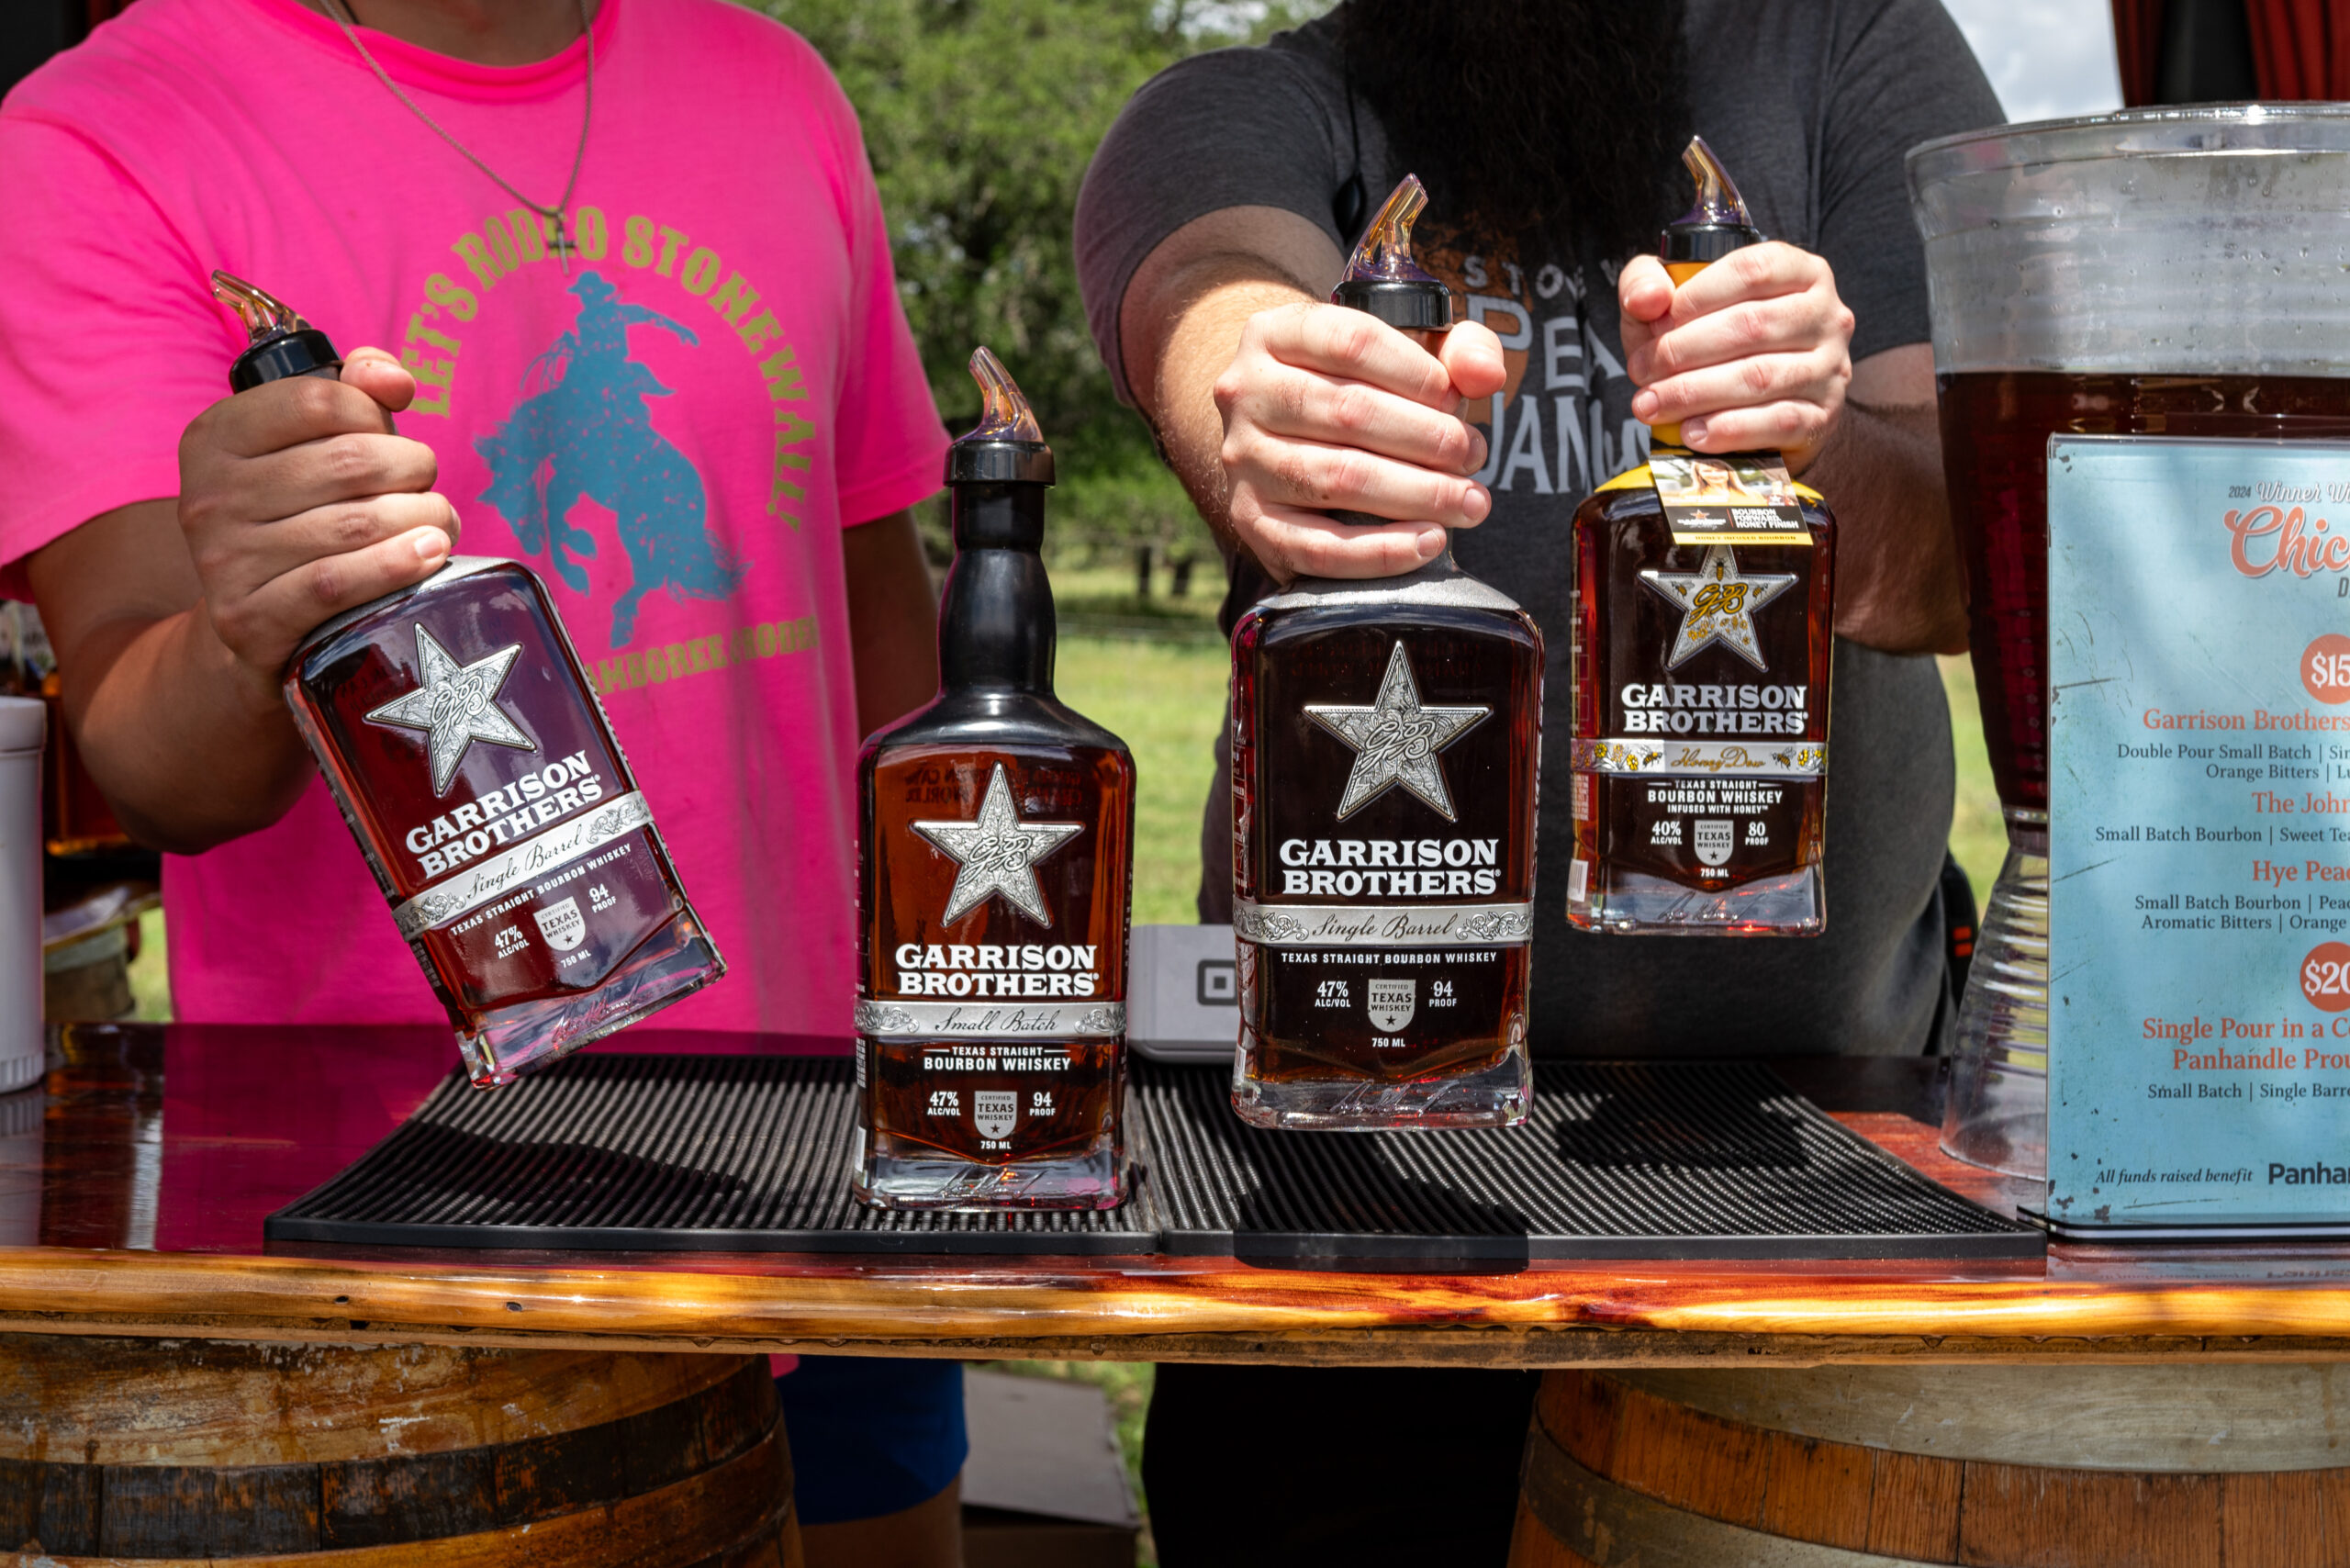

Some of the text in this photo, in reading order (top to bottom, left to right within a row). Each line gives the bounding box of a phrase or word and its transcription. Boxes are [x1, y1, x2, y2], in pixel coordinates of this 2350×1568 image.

[400, 205, 815, 532] LET'S RODEO STONEWALL!
[2228, 485, 2252, 498] 2024
[2255, 481, 2322, 503] Winner
[1621, 683, 1807, 709] GARRISON
[2143, 708, 2350, 731] Garrison Brothers
[1671, 745, 1766, 772] Honey Dew
[2117, 744, 2172, 759] Double
[2177, 745, 2215, 760] Pour
[2219, 744, 2263, 760] Small
[2268, 744, 2312, 759] Batch
[2206, 765, 2264, 783] Orange
[2268, 764, 2319, 778] Bitters
[1674, 780, 1757, 790] TEXAS STRAIGHT
[405, 750, 591, 856] GARRISON
[1648, 790, 1783, 803] BOURBON WHISKEY
[2251, 790, 2294, 813] The
[1667, 804, 1705, 813] INFUSED
[1708, 804, 1730, 813] WITH
[1652, 821, 1682, 835] 40%
[1697, 832, 1730, 841] TEXAS
[1748, 822, 1766, 836] 80
[2096, 826, 2140, 842] Small
[2147, 826, 2190, 842] Batch
[2194, 826, 2262, 843] Bourbon
[2280, 827, 2322, 842] Sweet
[1651, 836, 1683, 845] ALC/VOL
[1745, 837, 1769, 846] PROOF
[1280, 838, 1499, 868] GARRISON
[466, 826, 583, 900] Single Barrel
[1700, 868, 1729, 878] 750 ML
[2252, 860, 2298, 888] Hye
[450, 843, 632, 936] TEXAS STRAIGHT BOURBON WHISKEY
[588, 883, 609, 903] 94
[591, 896, 617, 913] PROOF
[2135, 894, 2179, 910] Small
[2185, 894, 2229, 910] Batch
[2234, 894, 2301, 910] Bourbon
[542, 909, 578, 932] TEXAS
[545, 918, 581, 939] WHISKEY
[1312, 914, 1457, 941] Single Barrel
[2142, 914, 2346, 934] Aromatic Bitters Orange
[494, 924, 524, 949] 47%
[498, 938, 530, 959] ALC/VOL
[560, 949, 591, 968] 750 ML
[895, 944, 1097, 971] GARRISON
[1281, 952, 1497, 964] TEXAS STRAIGHT BOURBON WHISKEY
[1316, 980, 1348, 998] 47%
[1371, 993, 1412, 1002] TEXAS
[1433, 980, 1454, 998] 94
[1315, 998, 1351, 1008] ALC/VOL
[1428, 998, 1458, 1008] PROOF
[934, 1007, 1061, 1032] Small Batch
[2142, 1016, 2212, 1045] Single
[2221, 1017, 2276, 1039] Pour
[2281, 1017, 2304, 1038] in
[2311, 1023, 2324, 1039] a
[1371, 1037, 1406, 1047] 750 ML
[952, 1047, 1043, 1056] TEXAS STRAIGHT
[2173, 1047, 2297, 1070] Panhandle
[923, 1057, 1071, 1070] BOURBON WHISKEY
[930, 1091, 958, 1107] 47%
[1034, 1092, 1052, 1107] 94
[2148, 1083, 2192, 1098] Small
[2199, 1083, 2242, 1098] Batch
[2260, 1082, 2307, 1102] Single
[927, 1107, 962, 1116] ALC/VOL
[978, 1103, 1013, 1113] TEXAS
[1030, 1108, 1056, 1116] PROOF
[980, 1141, 1012, 1149] 750 ML
[2095, 1169, 2254, 1184] All funds raised benefit
